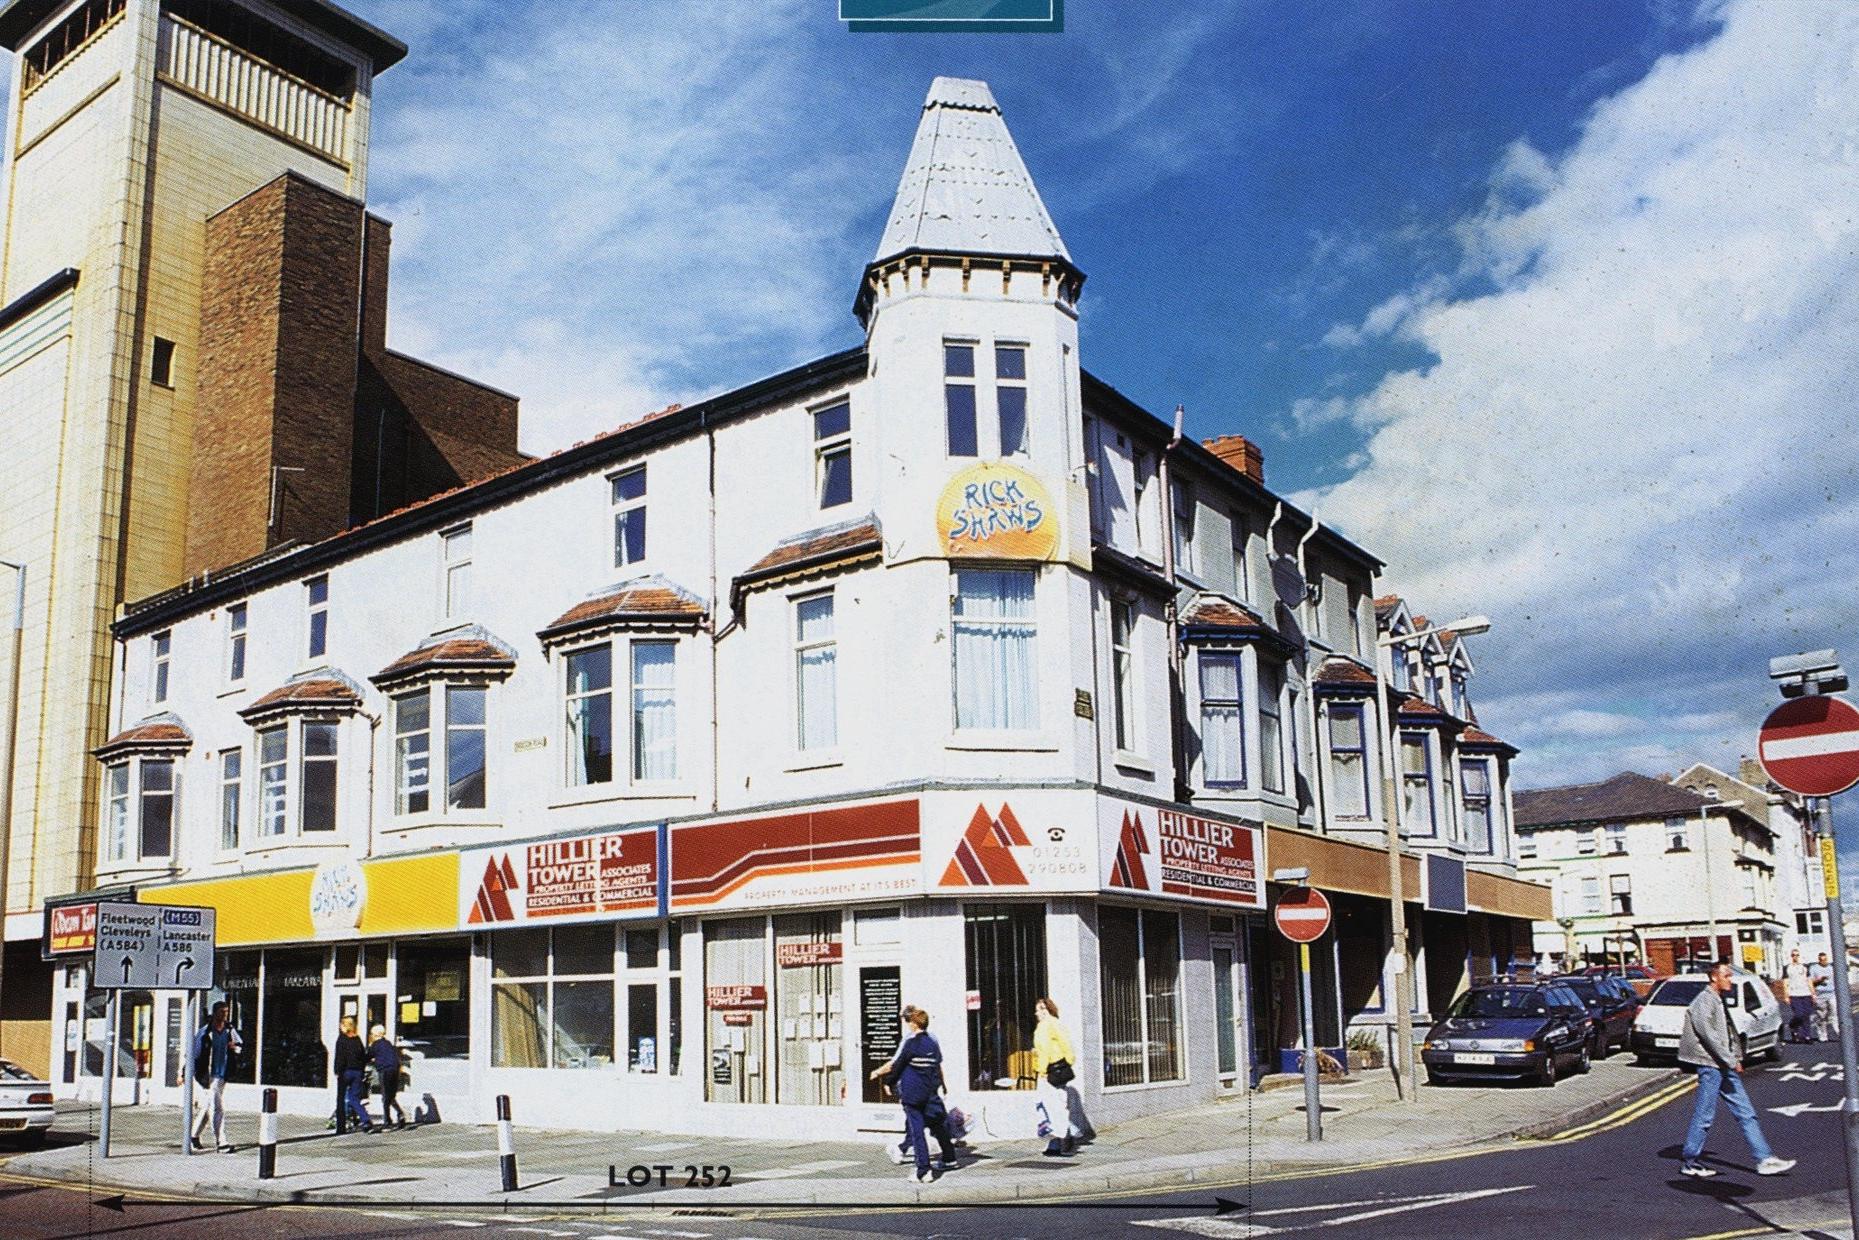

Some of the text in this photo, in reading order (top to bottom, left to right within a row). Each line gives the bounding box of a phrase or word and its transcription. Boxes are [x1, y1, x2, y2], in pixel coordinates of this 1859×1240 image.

[964, 479, 1024, 509] RICK
[950, 499, 1043, 539] SHAWS
[1160, 811, 1234, 848] HILLIER
[529, 836, 624, 867] HILLIER
[1160, 835, 1218, 864] TOWER
[1165, 857, 1200, 872] PROPERTY
[528, 862, 651, 886] TOWER ASSOCIATES
[1161, 867, 1205, 885] RESIDENTIAL
[1214, 878, 1256, 891] COMMERCIAL
[101, 912, 156, 926] Fleetwood
[164, 911, 200, 926] (M55)
[101, 925, 151, 939] Cleveleys
[163, 930, 211, 941] Lancaster
[100, 939, 145, 952] (A584)
[162, 942, 193, 952] A586
[780, 943, 830, 956] HILLIER
[779, 954, 817, 965] TOWER
[707, 986, 752, 998] HILLIER
[708, 997, 741, 1006] TOWER
